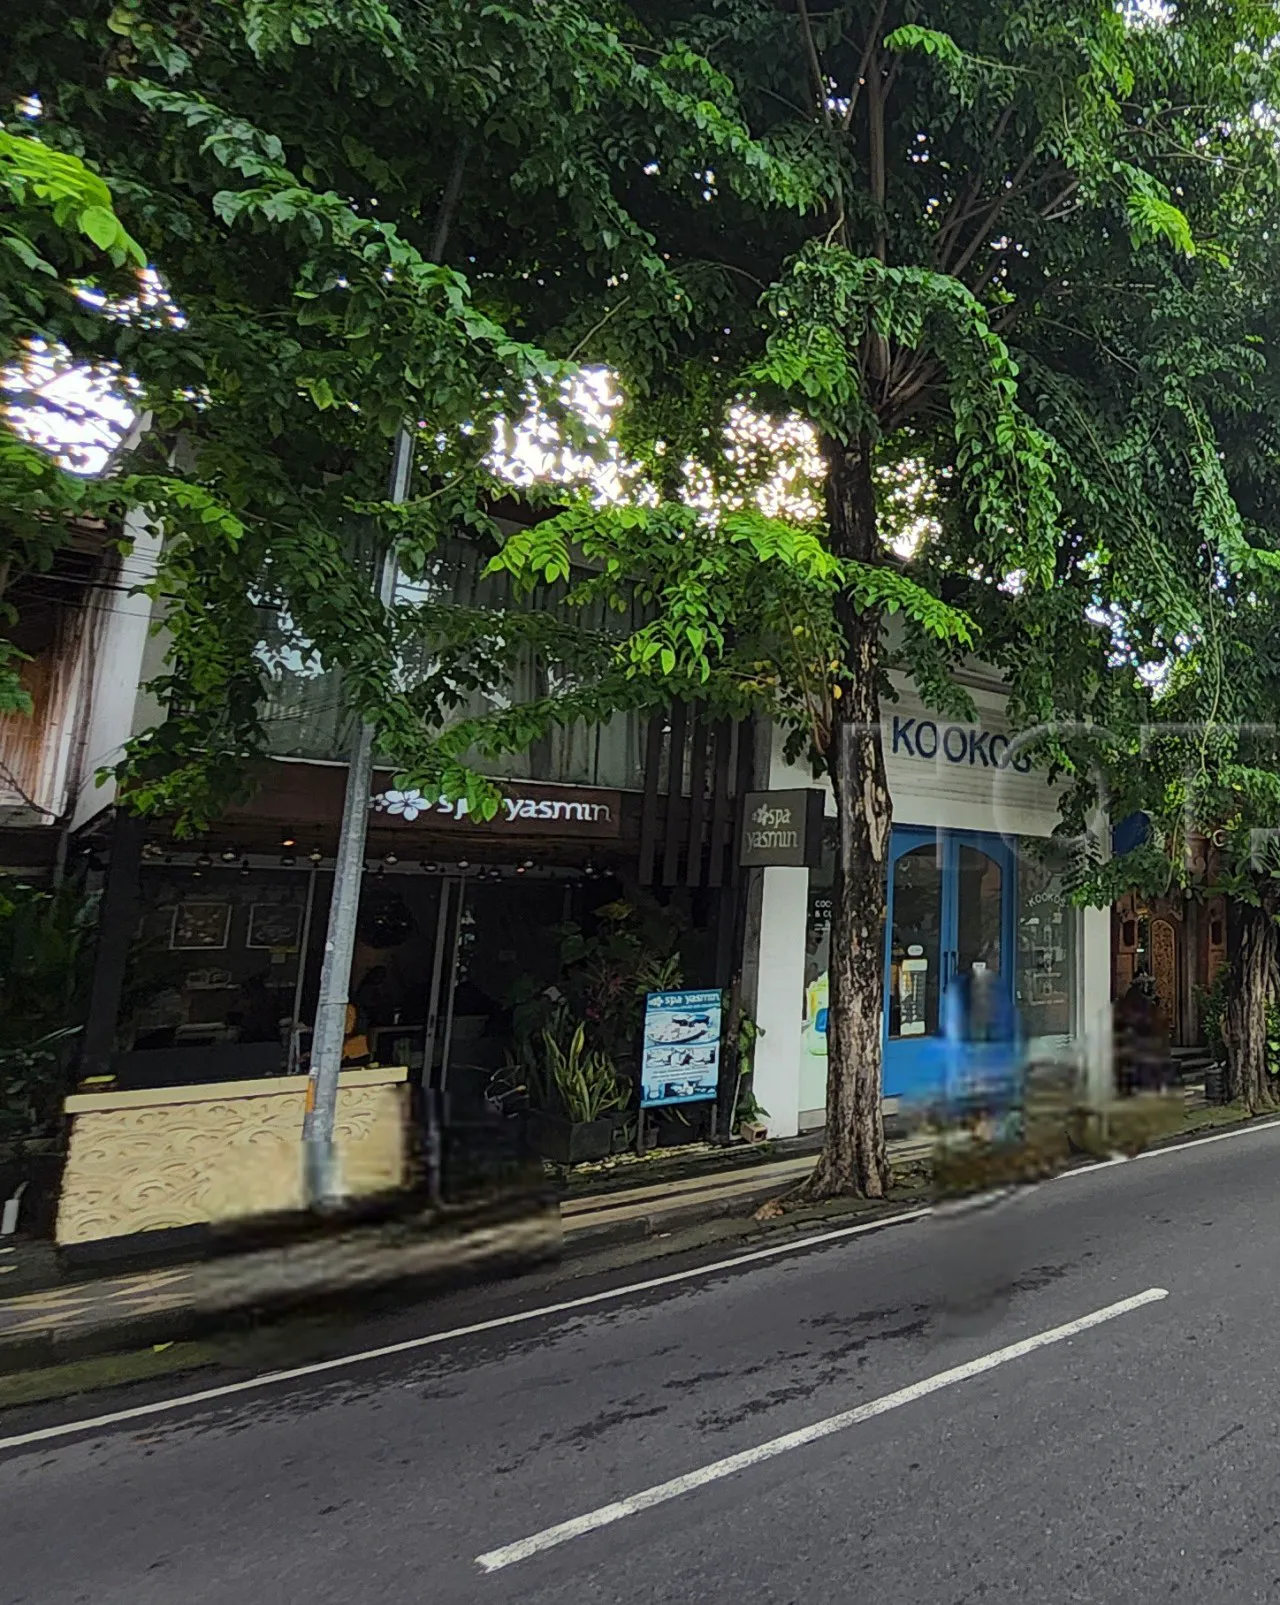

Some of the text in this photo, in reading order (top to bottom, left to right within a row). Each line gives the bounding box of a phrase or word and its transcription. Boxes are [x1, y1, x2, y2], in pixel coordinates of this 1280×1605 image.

[503, 798, 611, 823] yasmin
[768, 808, 791, 829] spa
[746, 830, 798, 853] yasmin
